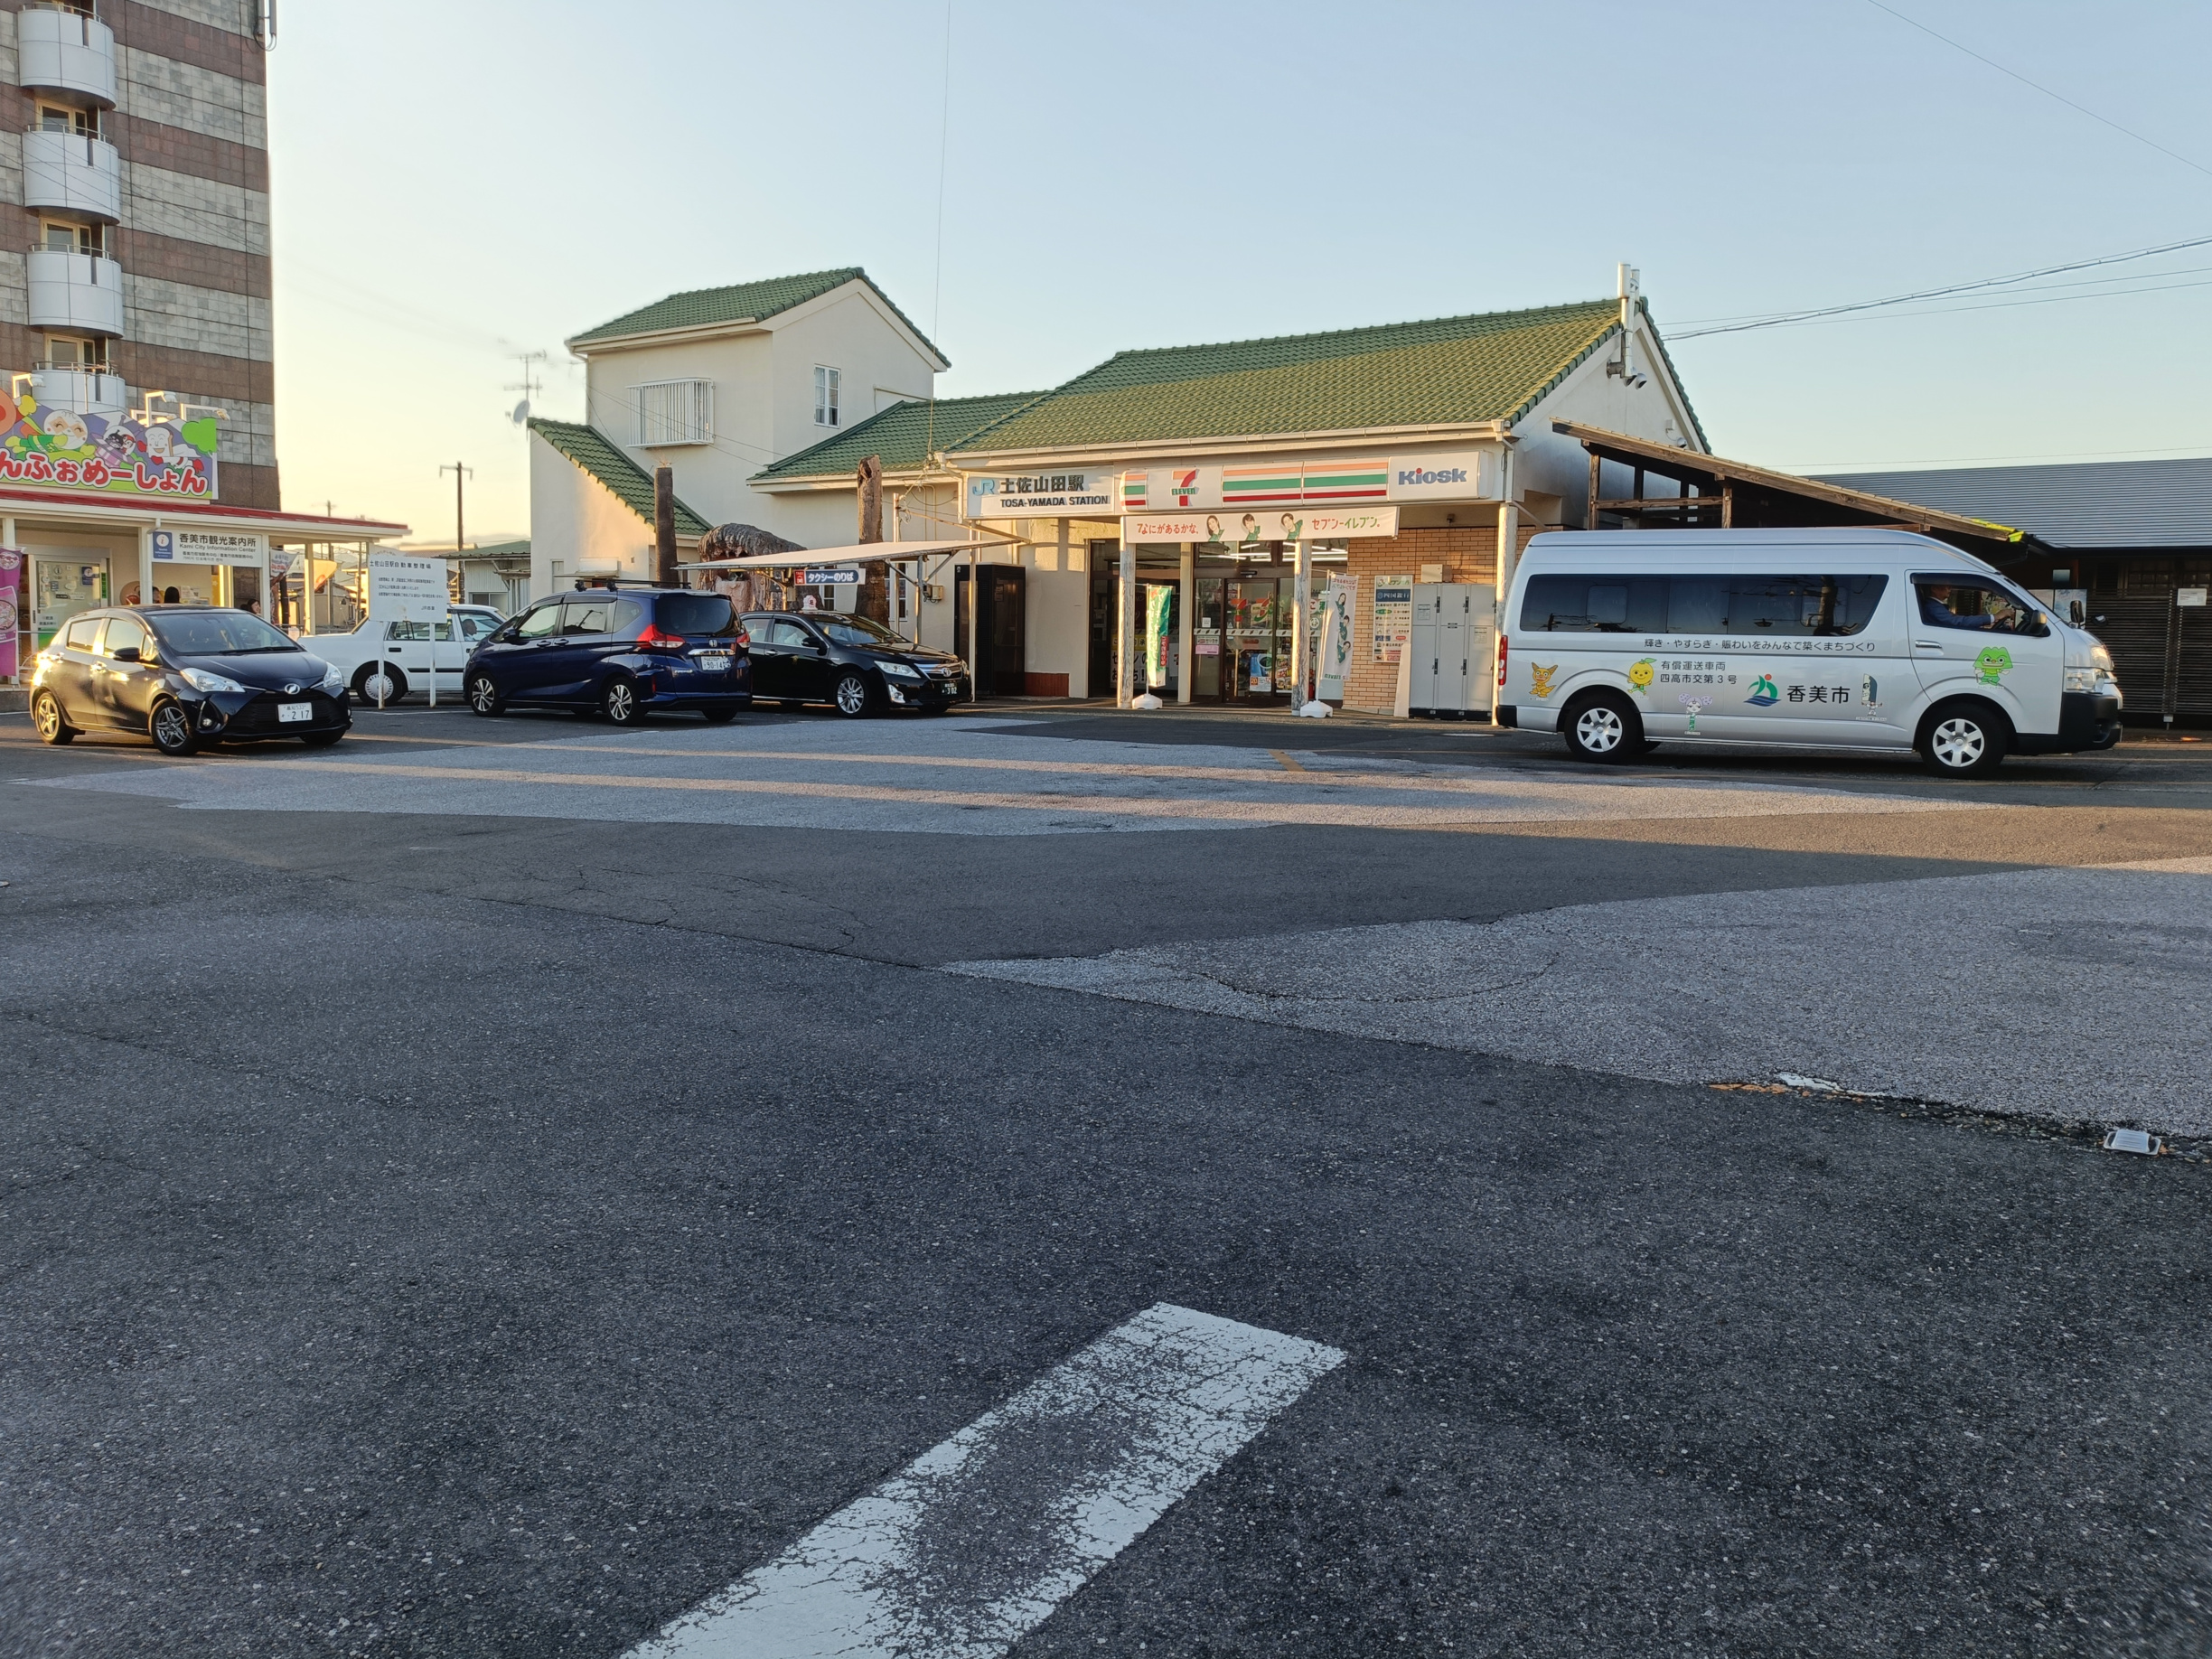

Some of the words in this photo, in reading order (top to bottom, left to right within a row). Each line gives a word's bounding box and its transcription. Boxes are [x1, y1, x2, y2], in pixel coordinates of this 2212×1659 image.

[1398, 467, 1467, 486] Kiosk
[972, 479, 995, 495] JR
[999, 474, 1084, 494] 土佐山田駅
[999, 498, 1065, 508] TOSA-YAMADA
[1068, 495, 1109, 505] STATION
[179, 533, 257, 548] 香美市観光案内所
[808, 571, 854, 582] タクシーのりば
[1661, 661, 1727, 671] 有償運送車両
[1786, 684, 1851, 704] 香美市
